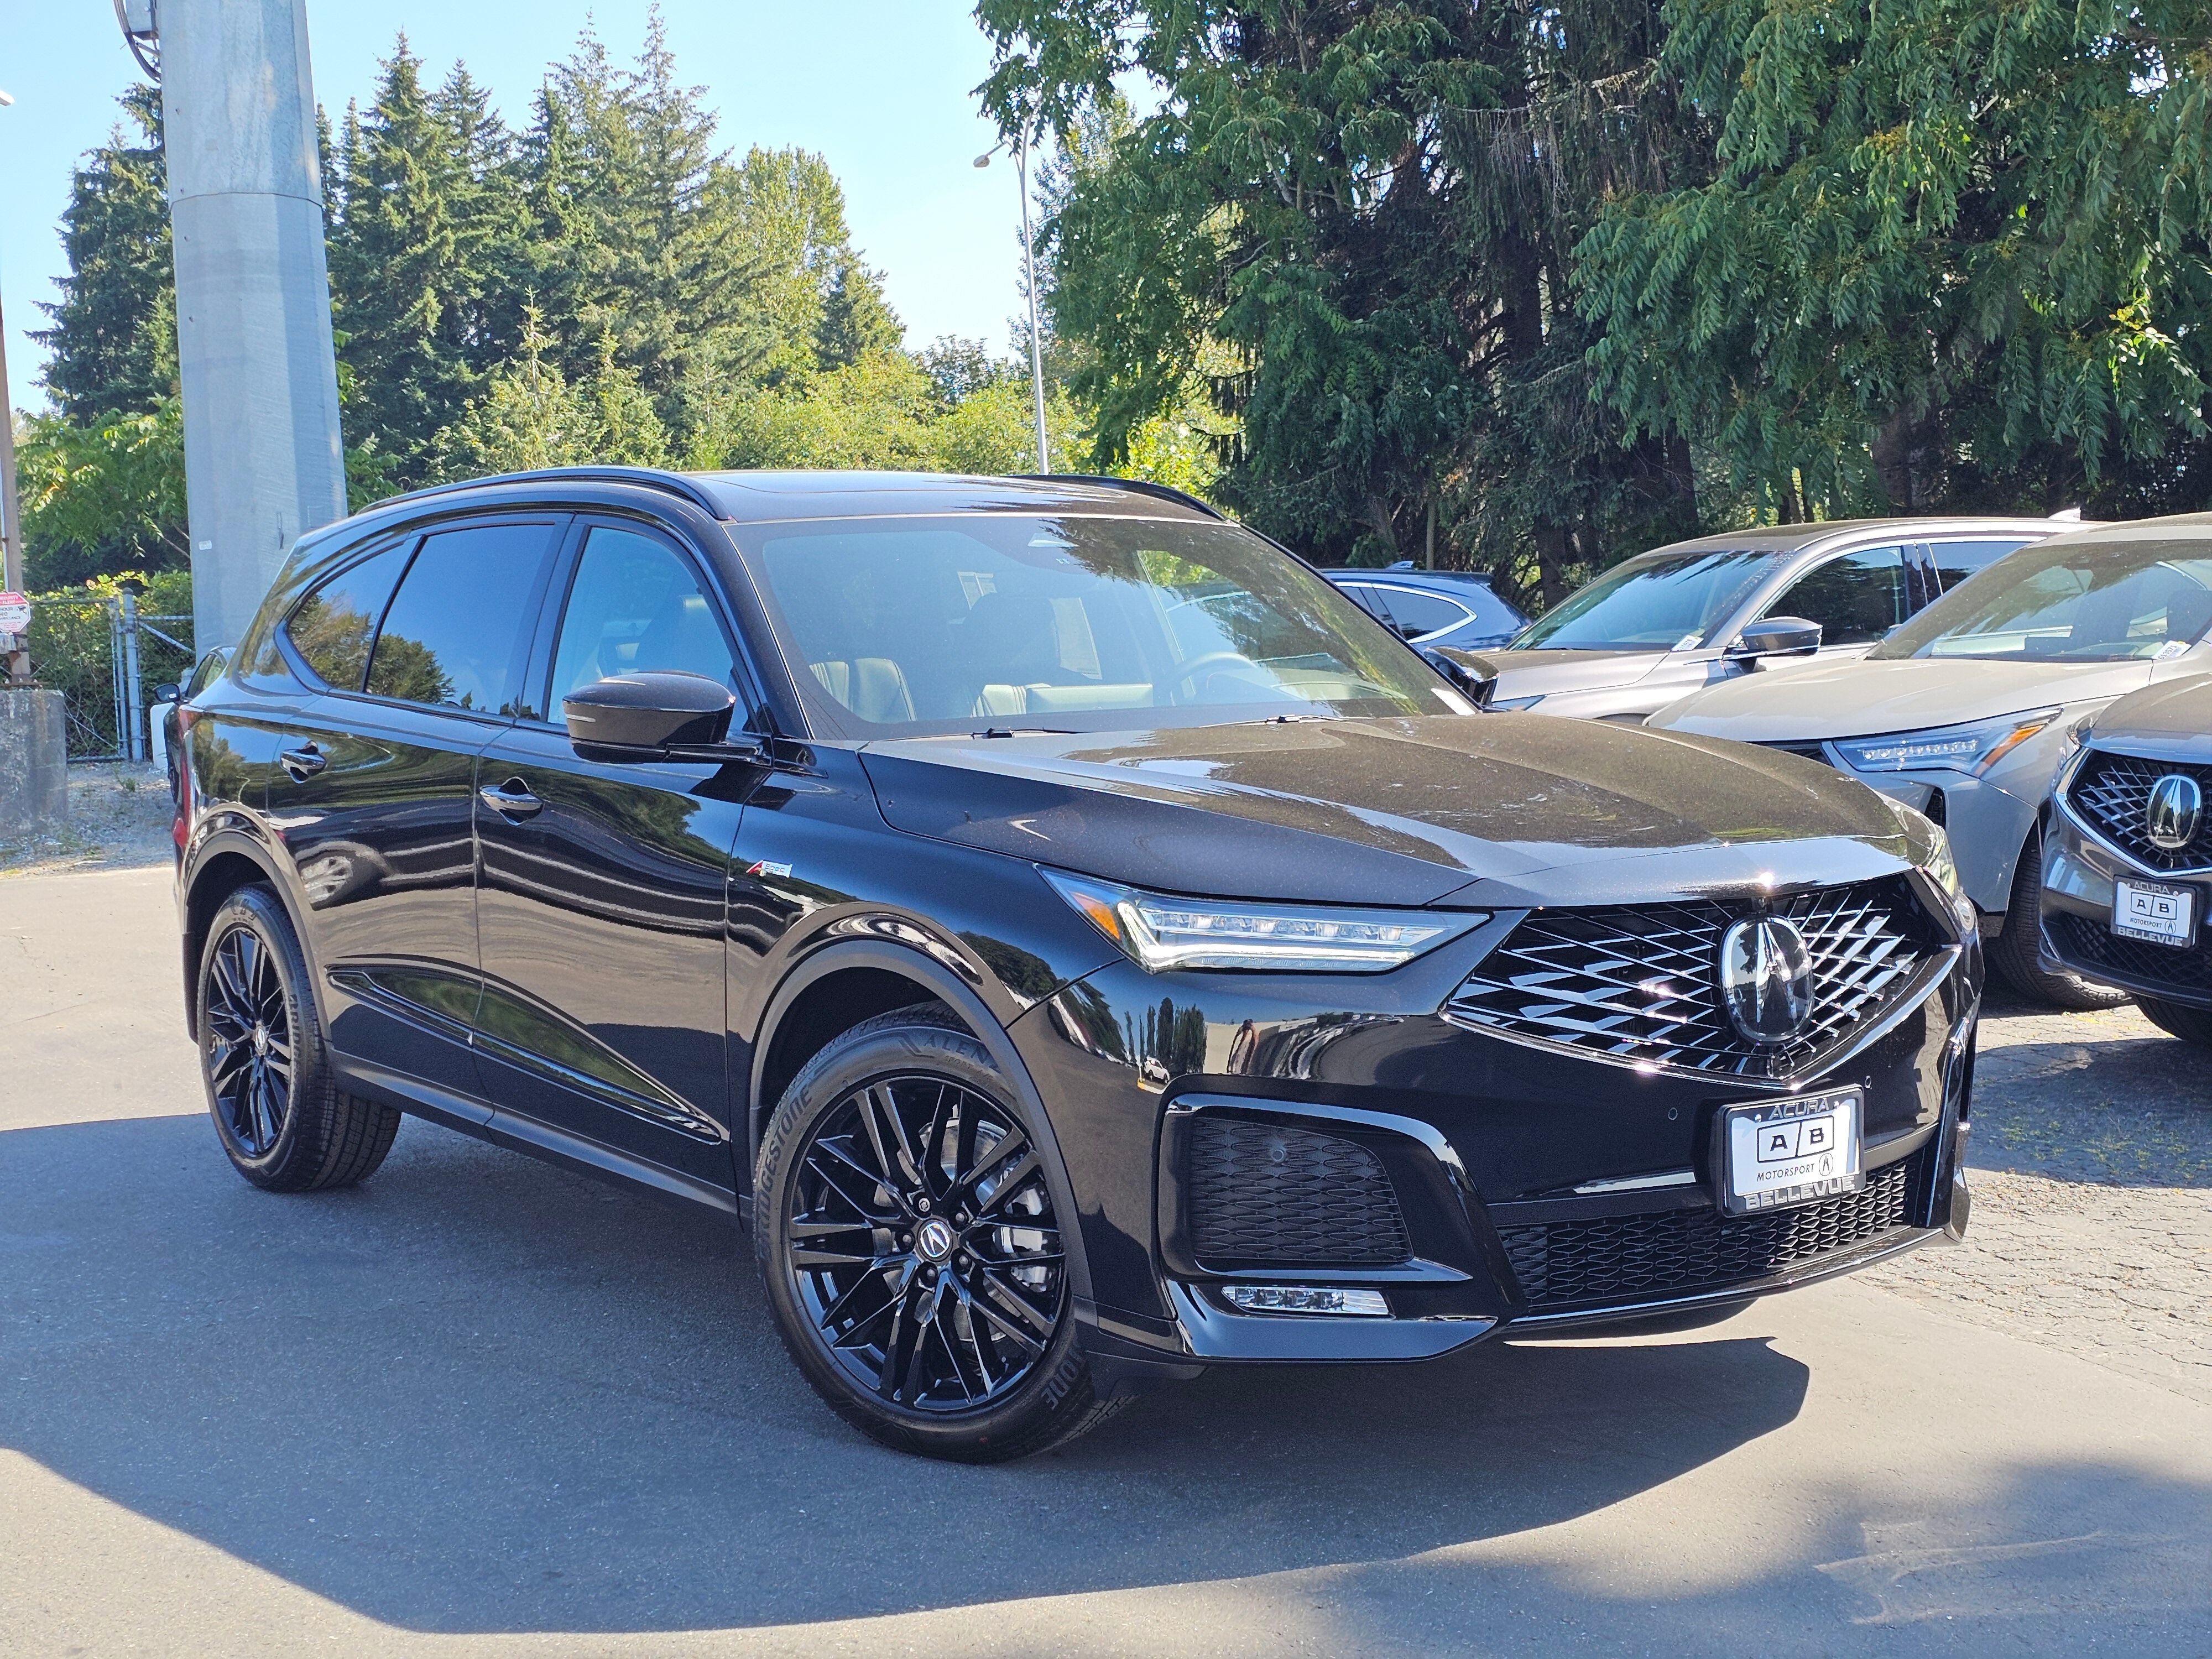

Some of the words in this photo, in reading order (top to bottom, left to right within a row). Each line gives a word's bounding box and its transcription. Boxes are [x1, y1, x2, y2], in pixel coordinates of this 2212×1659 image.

[2134, 881, 2170, 894] ACURA
[2137, 899, 2146, 909] A
[2159, 903, 2169, 913] B
[2130, 917, 2162, 928] MOTORSPORT
[2117, 926, 2183, 946] BELLEVUE
[1768, 1098, 1829, 1120] ACURA
[1770, 1135, 1788, 1151] A
[1809, 1128, 1824, 1145] B
[1757, 1163, 1815, 1182] MOTORSPORT
[1744, 1176, 1855, 1210] BELLEVUE
